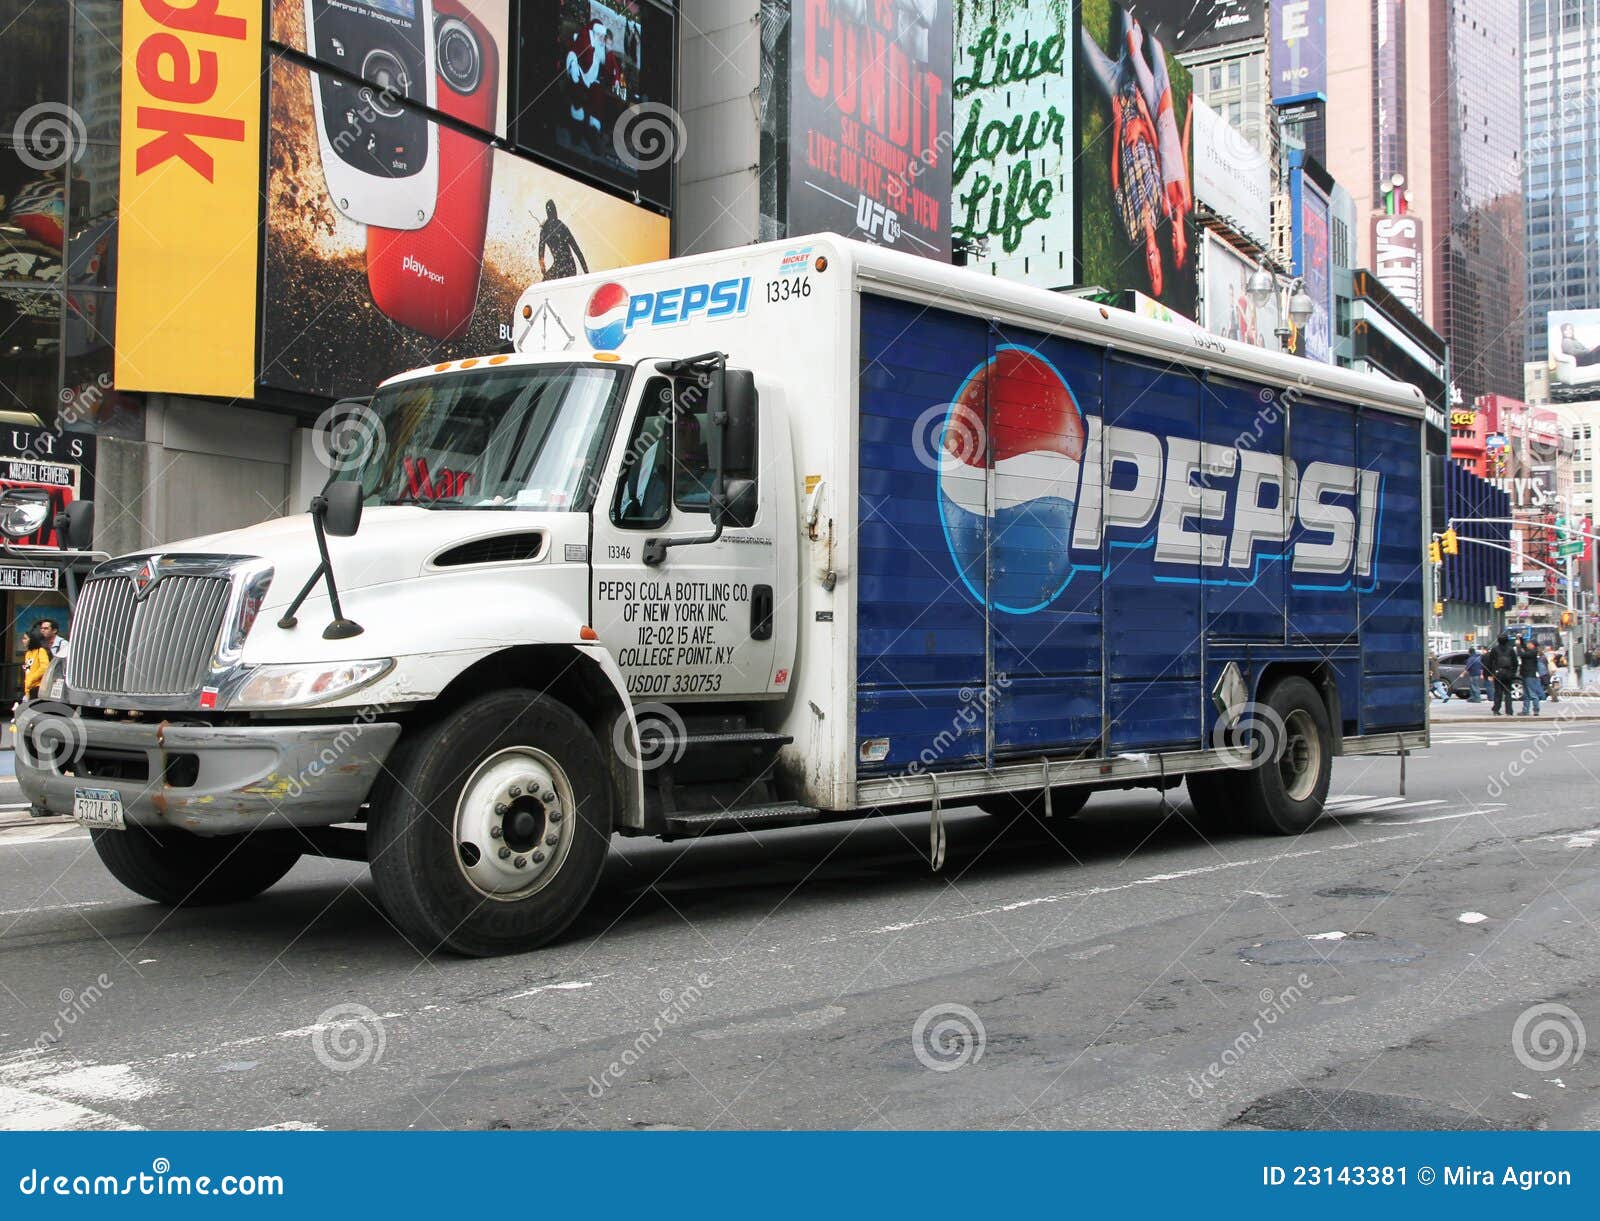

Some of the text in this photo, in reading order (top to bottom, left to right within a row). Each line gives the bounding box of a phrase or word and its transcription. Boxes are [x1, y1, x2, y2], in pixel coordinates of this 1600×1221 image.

[953, 26, 1066, 99] Live
[804, 0, 942, 169] CONDIT
[1282, 67, 1310, 82] NYC
[808, 128, 838, 178] LIVE
[840, 147, 857, 189] ON
[953, 160, 1052, 253] Life
[856, 194, 898, 243] UFC
[402, 254, 425, 278] play
[781, 253, 810, 265] MICKEY
[766, 276, 811, 303] 13346
[625, 276, 752, 330] PEPSI
[9, 462, 69, 485] MICHAEL CERVERIS
[1072, 414, 1381, 577] PEPSI
[608, 546, 631, 559] 13346
[20, 570, 54, 588] GRANDAGE
[599, 581, 749, 602] PEPSI COLA BOTTLING CO.
[623, 603, 728, 622] OF NEW YORK INC.
[638, 626, 716, 645] 112-02 15 AVE.
[618, 648, 673, 667] COLLEGE
[627, 674, 722, 693] USDOT 330753
